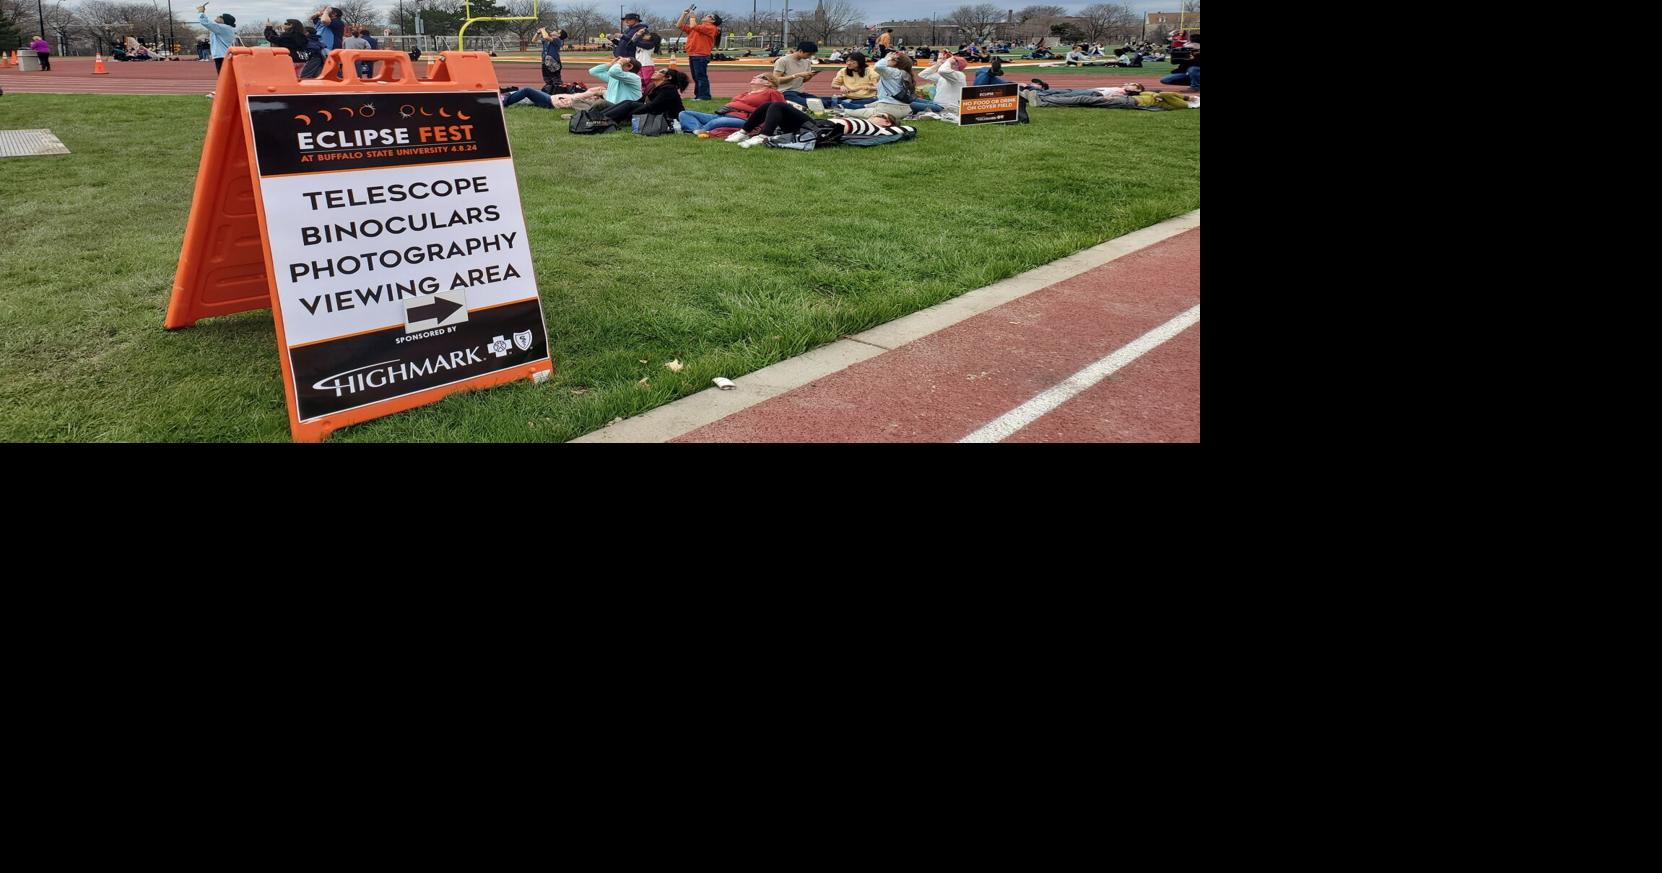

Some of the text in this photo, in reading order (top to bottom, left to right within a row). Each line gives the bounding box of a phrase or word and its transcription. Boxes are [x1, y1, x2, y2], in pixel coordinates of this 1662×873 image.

[297, 124, 474, 149] ECLIPSE FEST
[301, 144, 478, 163] AT BUFFALO STATE UNIVERSITY 4.8.24
[302, 176, 489, 210] TELESCOPE
[301, 204, 501, 246] BINOCULARS
[289, 231, 517, 283] PHOTOGRAPHY
[299, 263, 521, 315] VIEWING AREA
[395, 325, 457, 344] SPONSORED BY
[313, 346, 481, 397] HIGHMARK
